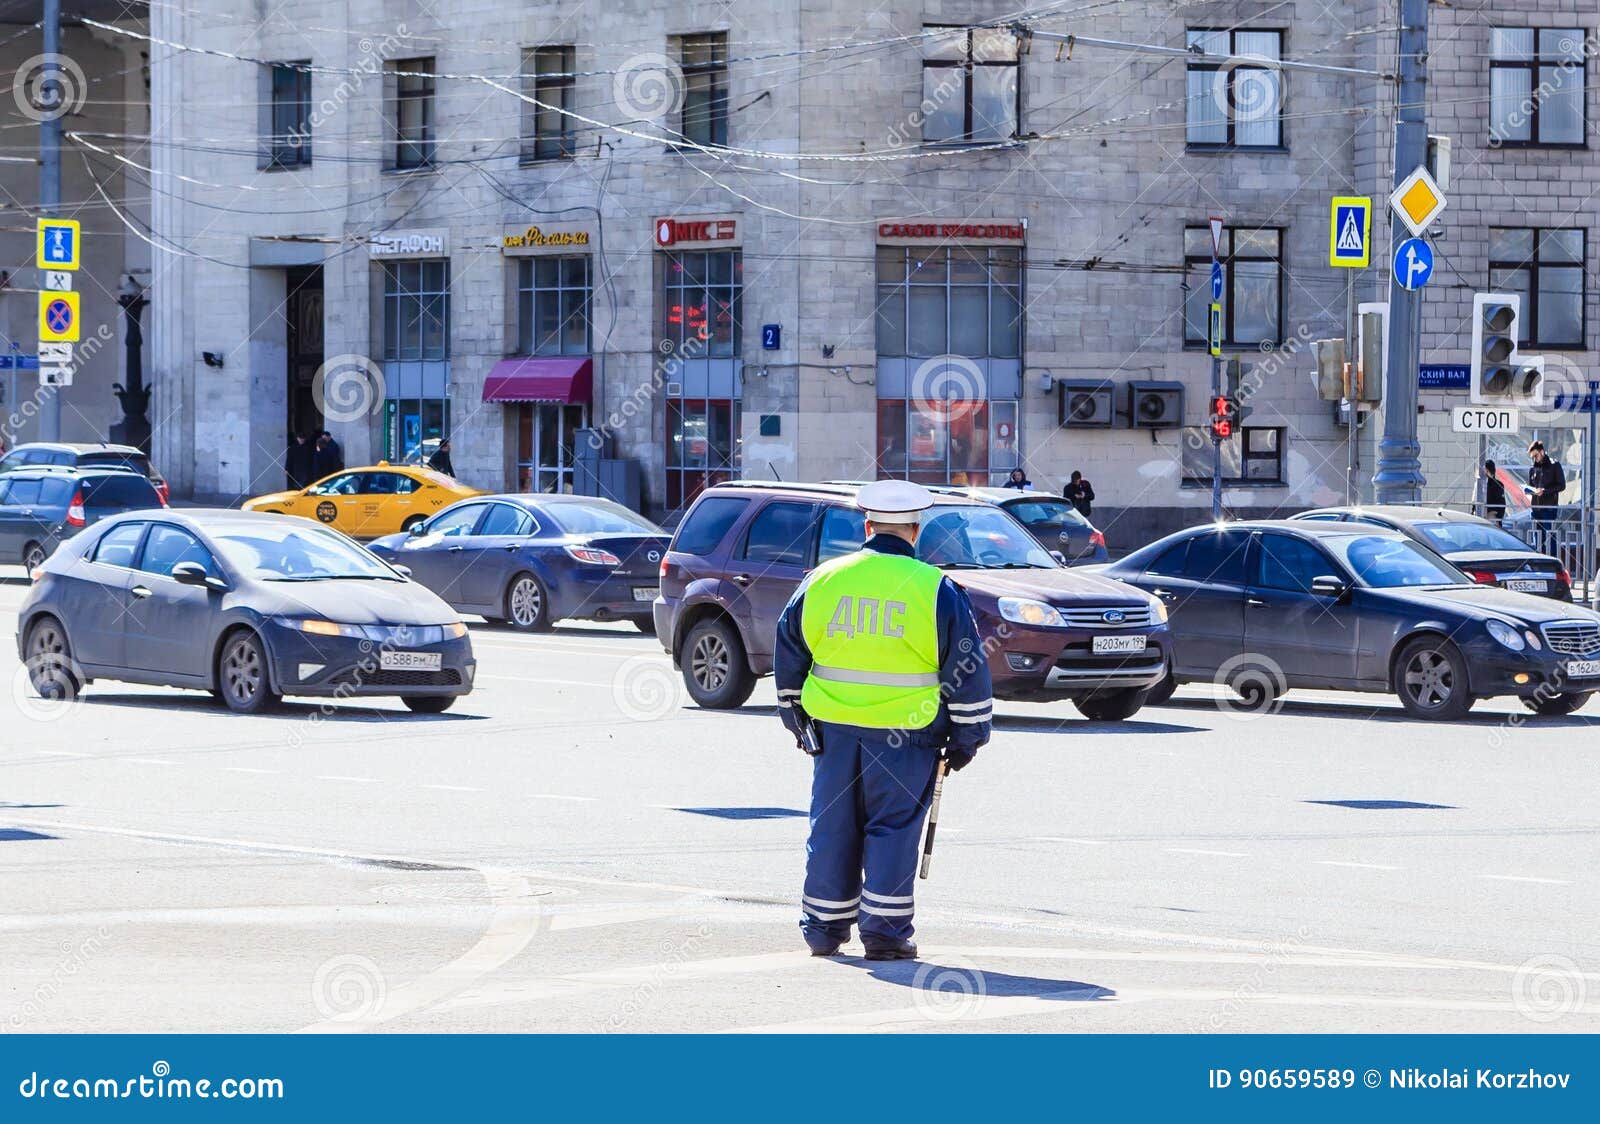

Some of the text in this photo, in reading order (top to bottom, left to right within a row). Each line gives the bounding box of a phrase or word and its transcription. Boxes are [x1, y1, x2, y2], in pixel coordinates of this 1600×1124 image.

[676, 221, 711, 241] МТС
[879, 223, 1024, 239] САЛОН КРАСОТЫ
[766, 329, 774, 345] 2
[1447, 370, 1465, 379] ВАЛ
[1462, 411, 1510, 429] СТОП
[827, 595, 906, 639] ДПС
